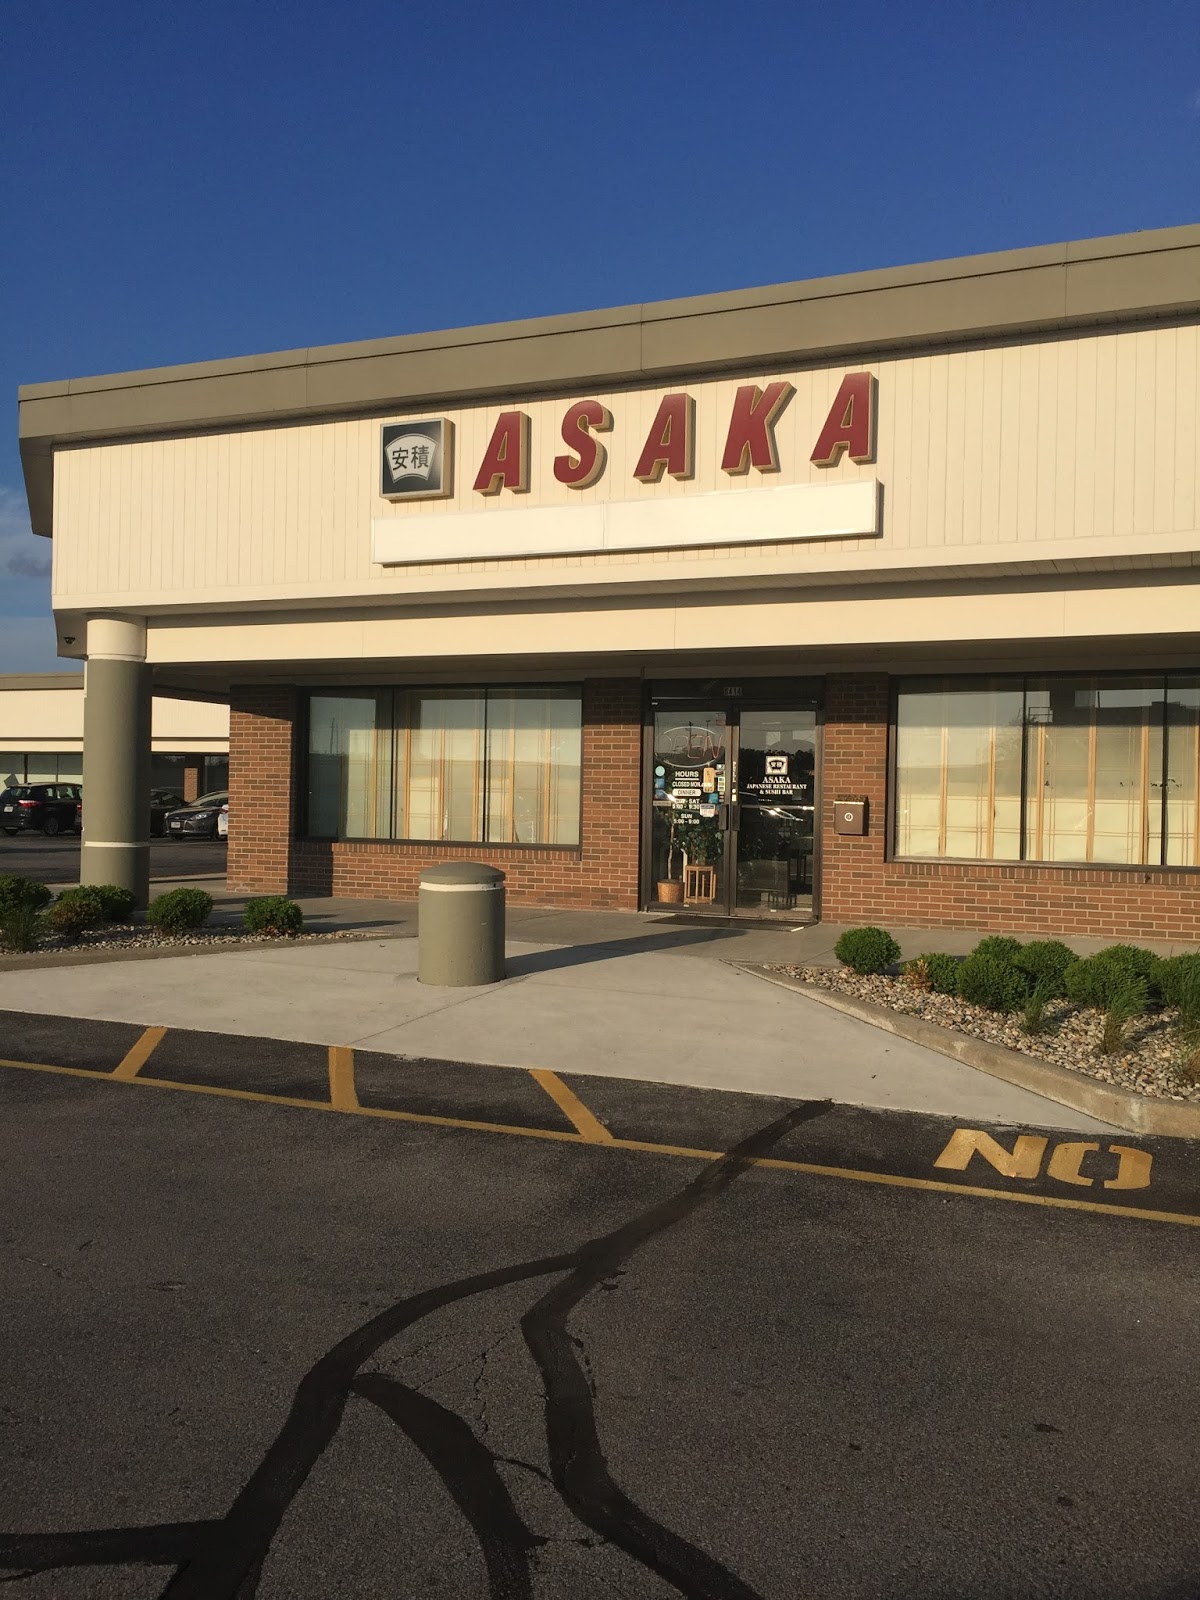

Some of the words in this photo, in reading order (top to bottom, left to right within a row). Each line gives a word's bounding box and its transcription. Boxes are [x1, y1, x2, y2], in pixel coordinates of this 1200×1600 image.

[392, 445, 430, 471] 安積
[473, 371, 879, 494] ASAKA
[933, 1128, 1153, 1190] NO
